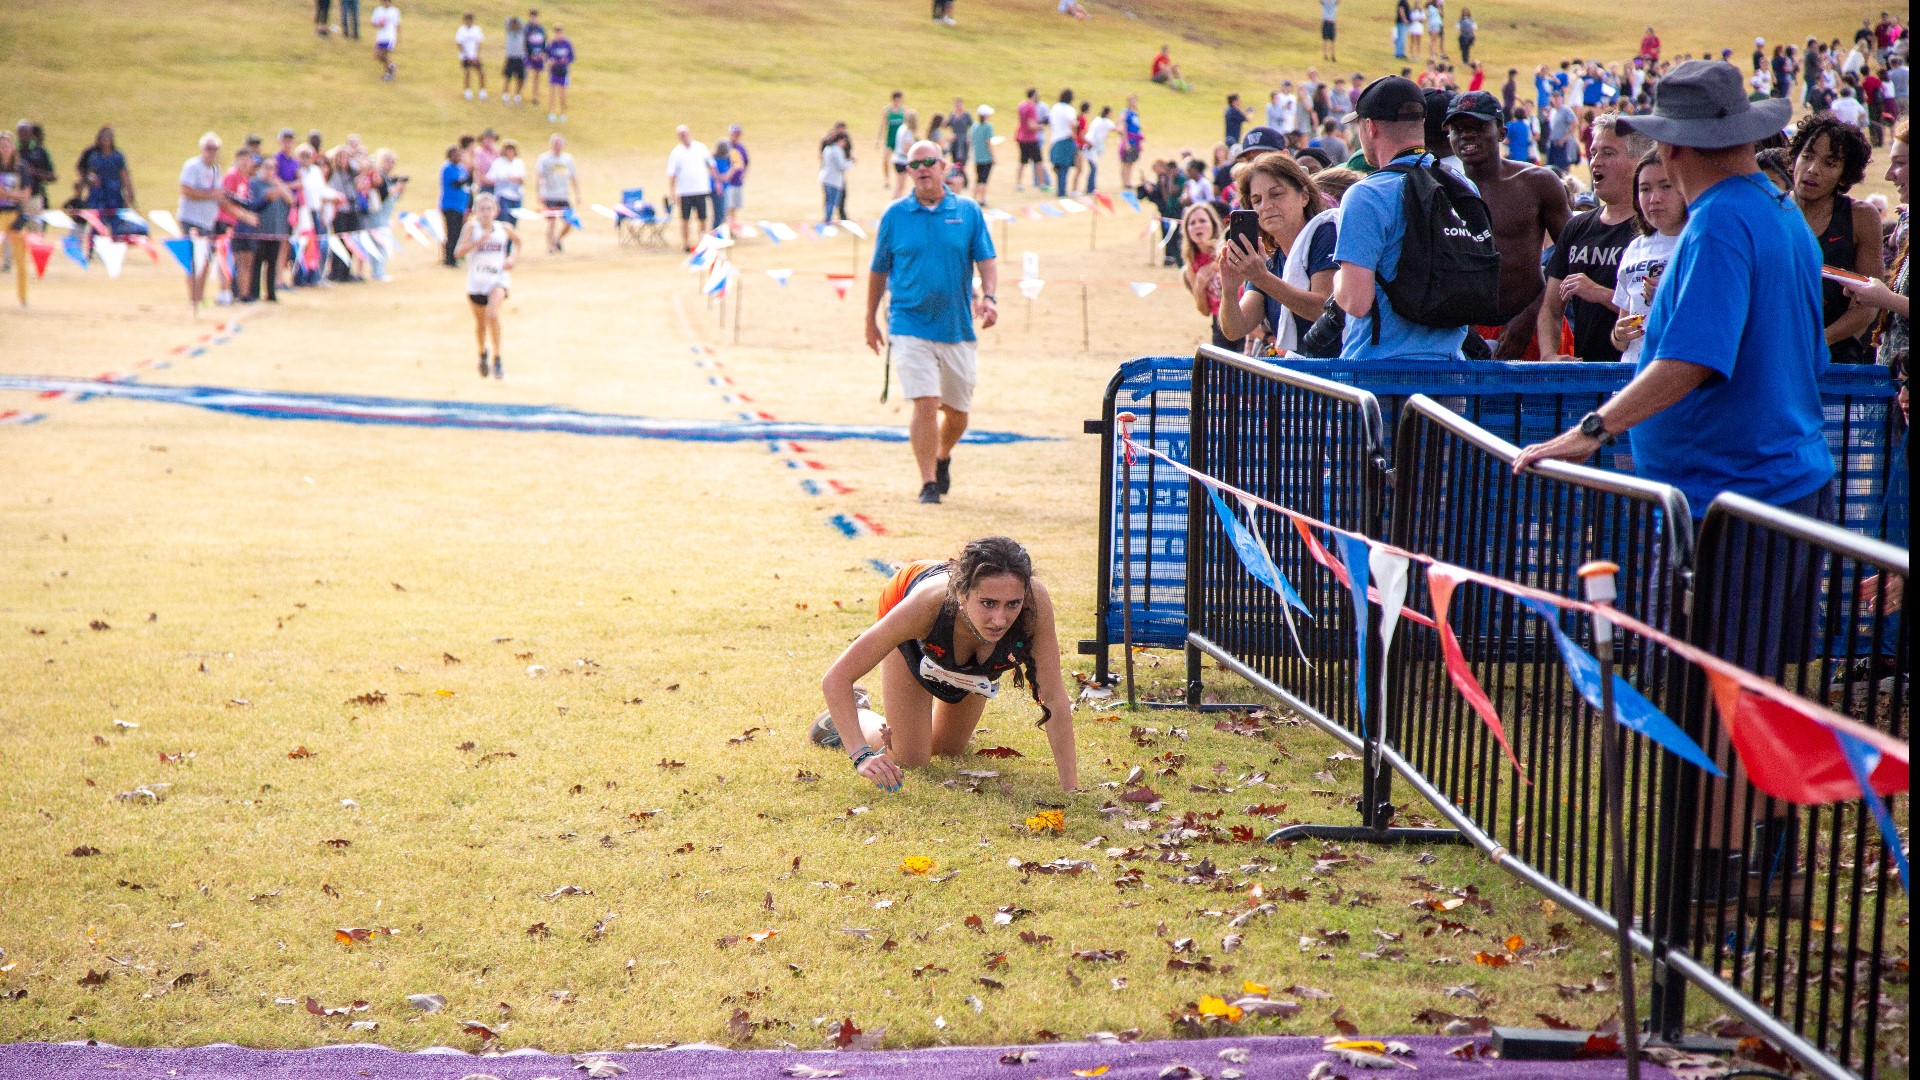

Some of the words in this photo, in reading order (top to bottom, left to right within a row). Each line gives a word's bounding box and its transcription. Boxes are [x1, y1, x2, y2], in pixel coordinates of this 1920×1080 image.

[1247, 131, 1263, 145] W
[1443, 227, 1492, 242] CONVSE
[1568, 245, 1623, 266] BANK
